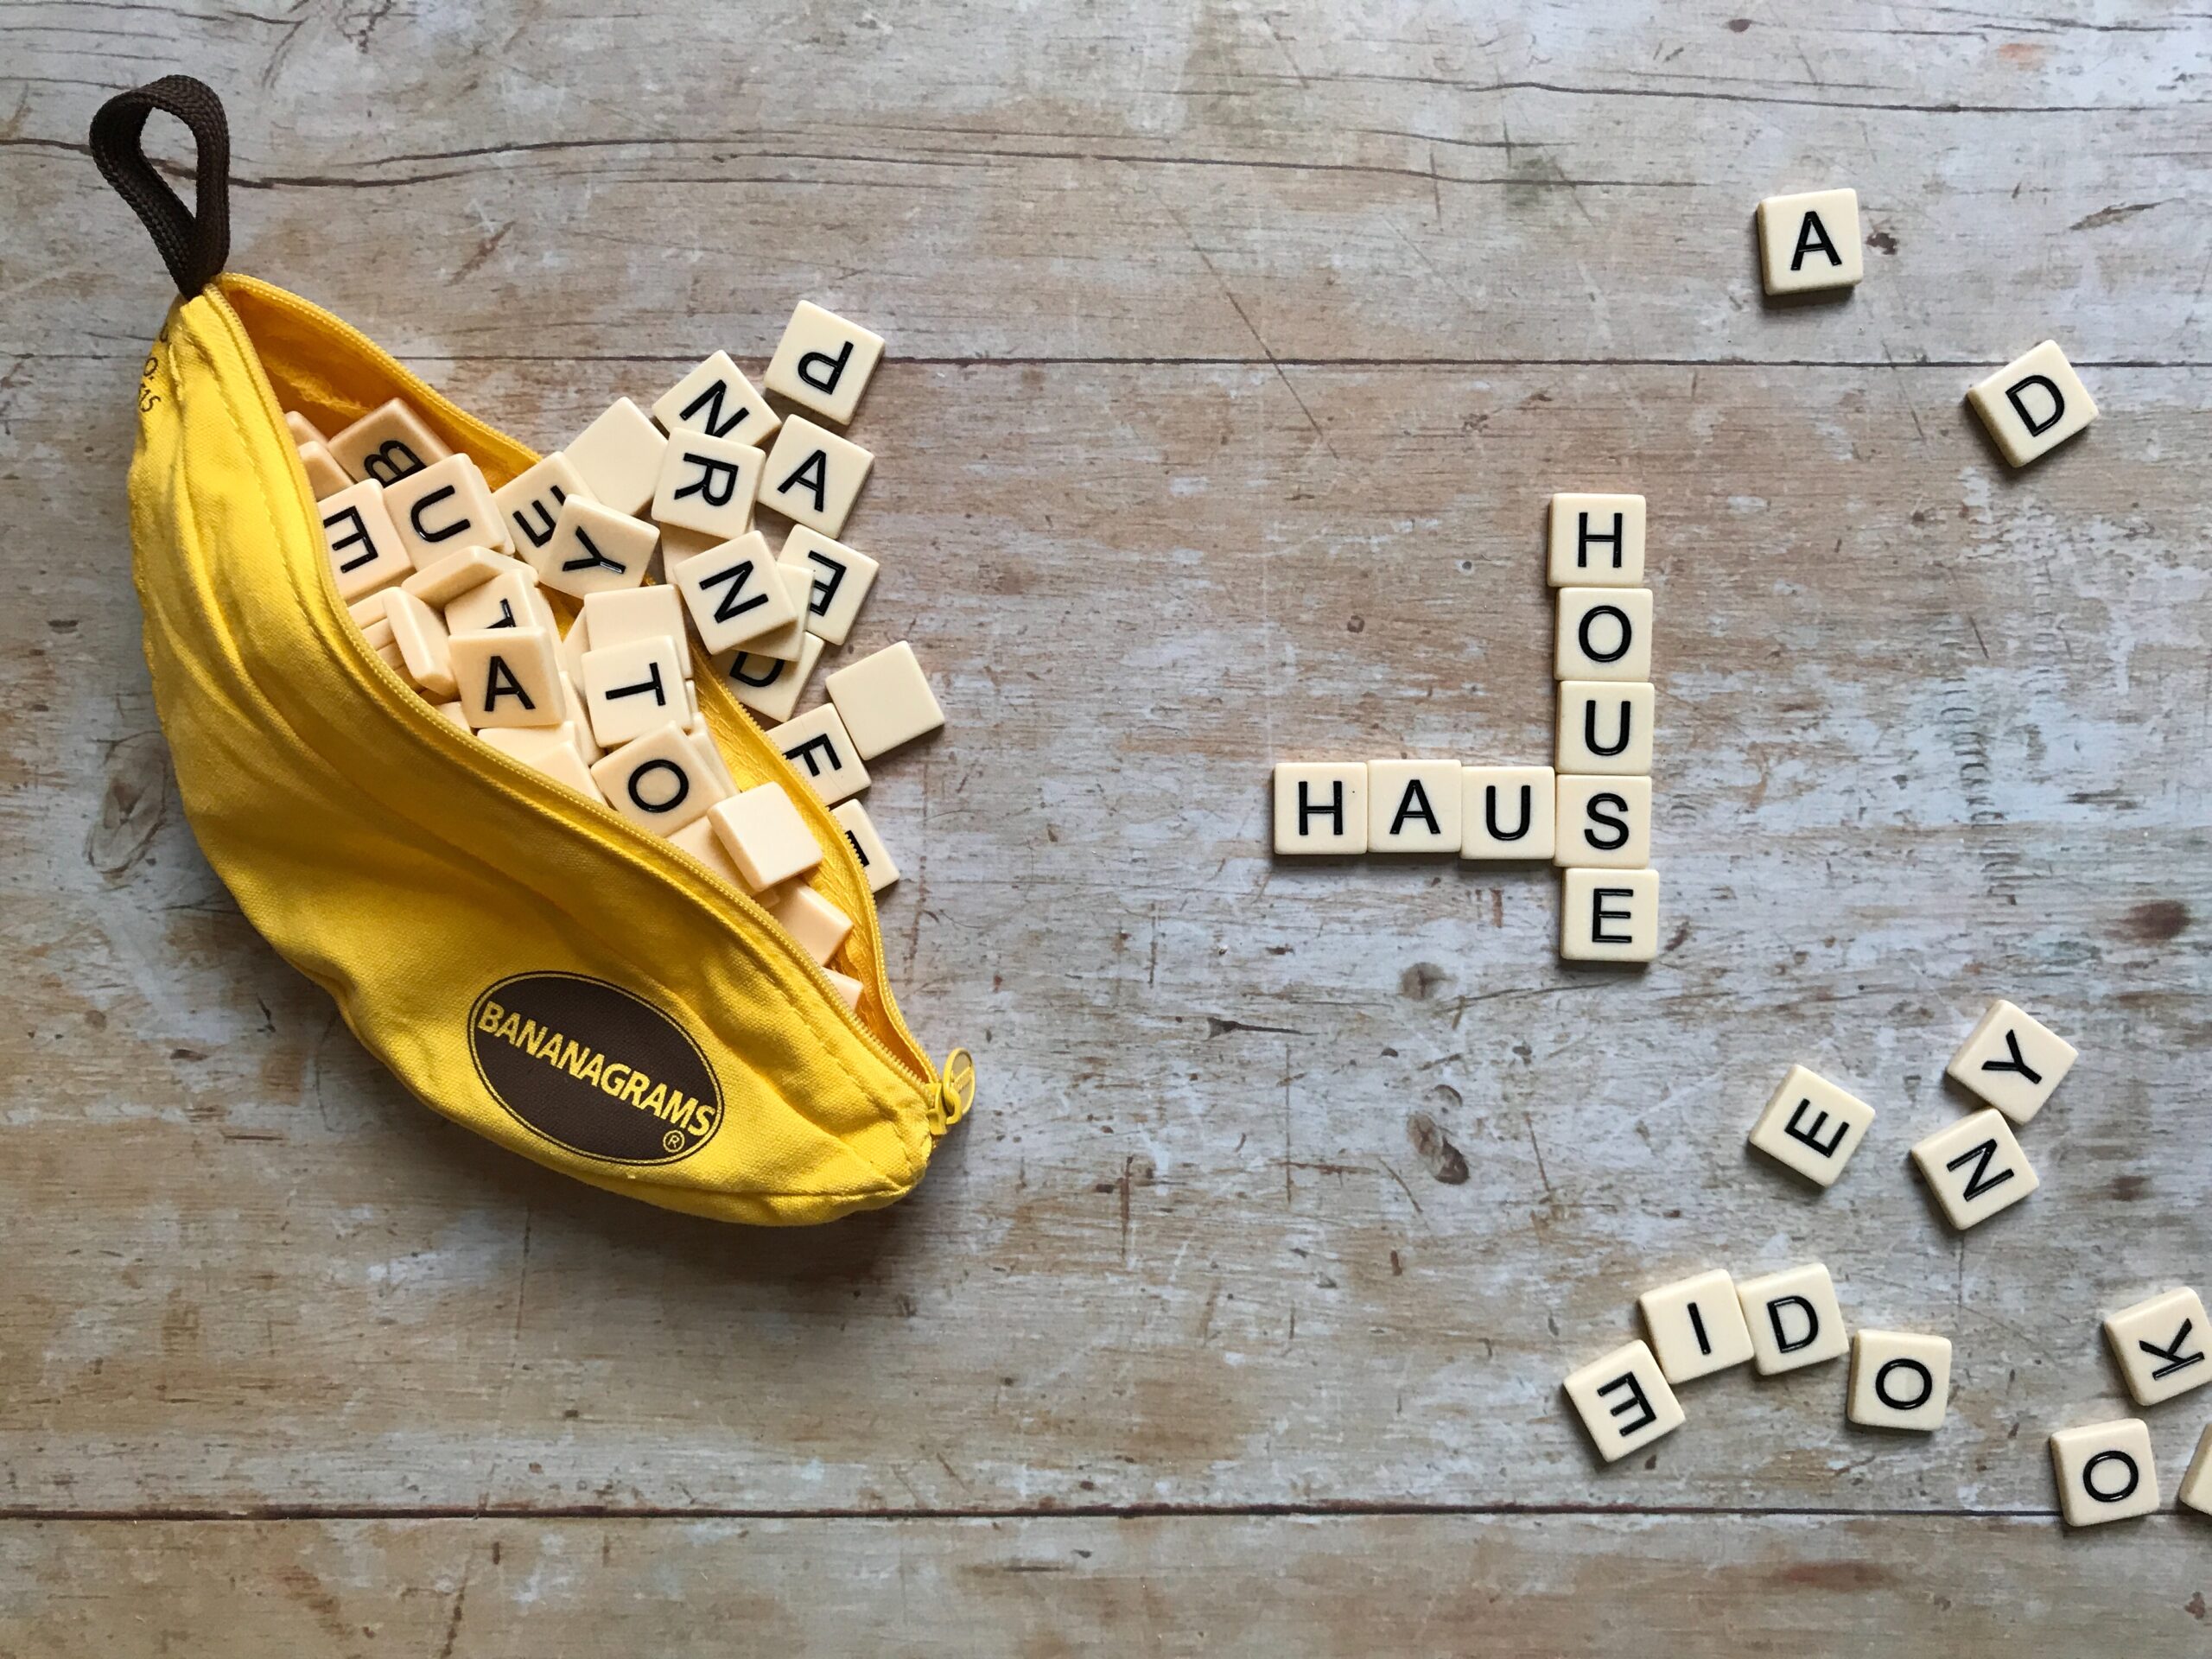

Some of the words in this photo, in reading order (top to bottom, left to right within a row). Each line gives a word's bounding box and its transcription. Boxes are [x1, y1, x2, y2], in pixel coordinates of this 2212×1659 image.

[1790, 210, 1842, 271] A
[798, 340, 854, 395] P
[2005, 374, 2065, 438] D
[674, 452, 739, 507] R
[777, 449, 827, 513] A
[322, 505, 378, 574] E
[410, 485, 471, 543] U
[562, 525, 626, 575] Y
[698, 560, 769, 624] N
[484, 655, 536, 712] A
[605, 662, 666, 707] T
[1577, 512, 1634, 944] HOUSE
[627, 759, 690, 814] O
[1298, 779, 1630, 850] HAUS
[477, 1001, 715, 1137] BANANAGRAMS
[1981, 1029, 2043, 1084] Y
[1784, 1098, 1850, 1159] E
[1946, 1138, 2015, 1202] N
[1687, 1302, 1712, 1356] I
[1766, 1295, 1819, 1354] D
[2139, 1318, 2205, 1381] K
[1597, 1371, 1657, 1437] E
[1875, 1357, 1933, 1411] O
[2082, 1450, 2139, 1503] O
